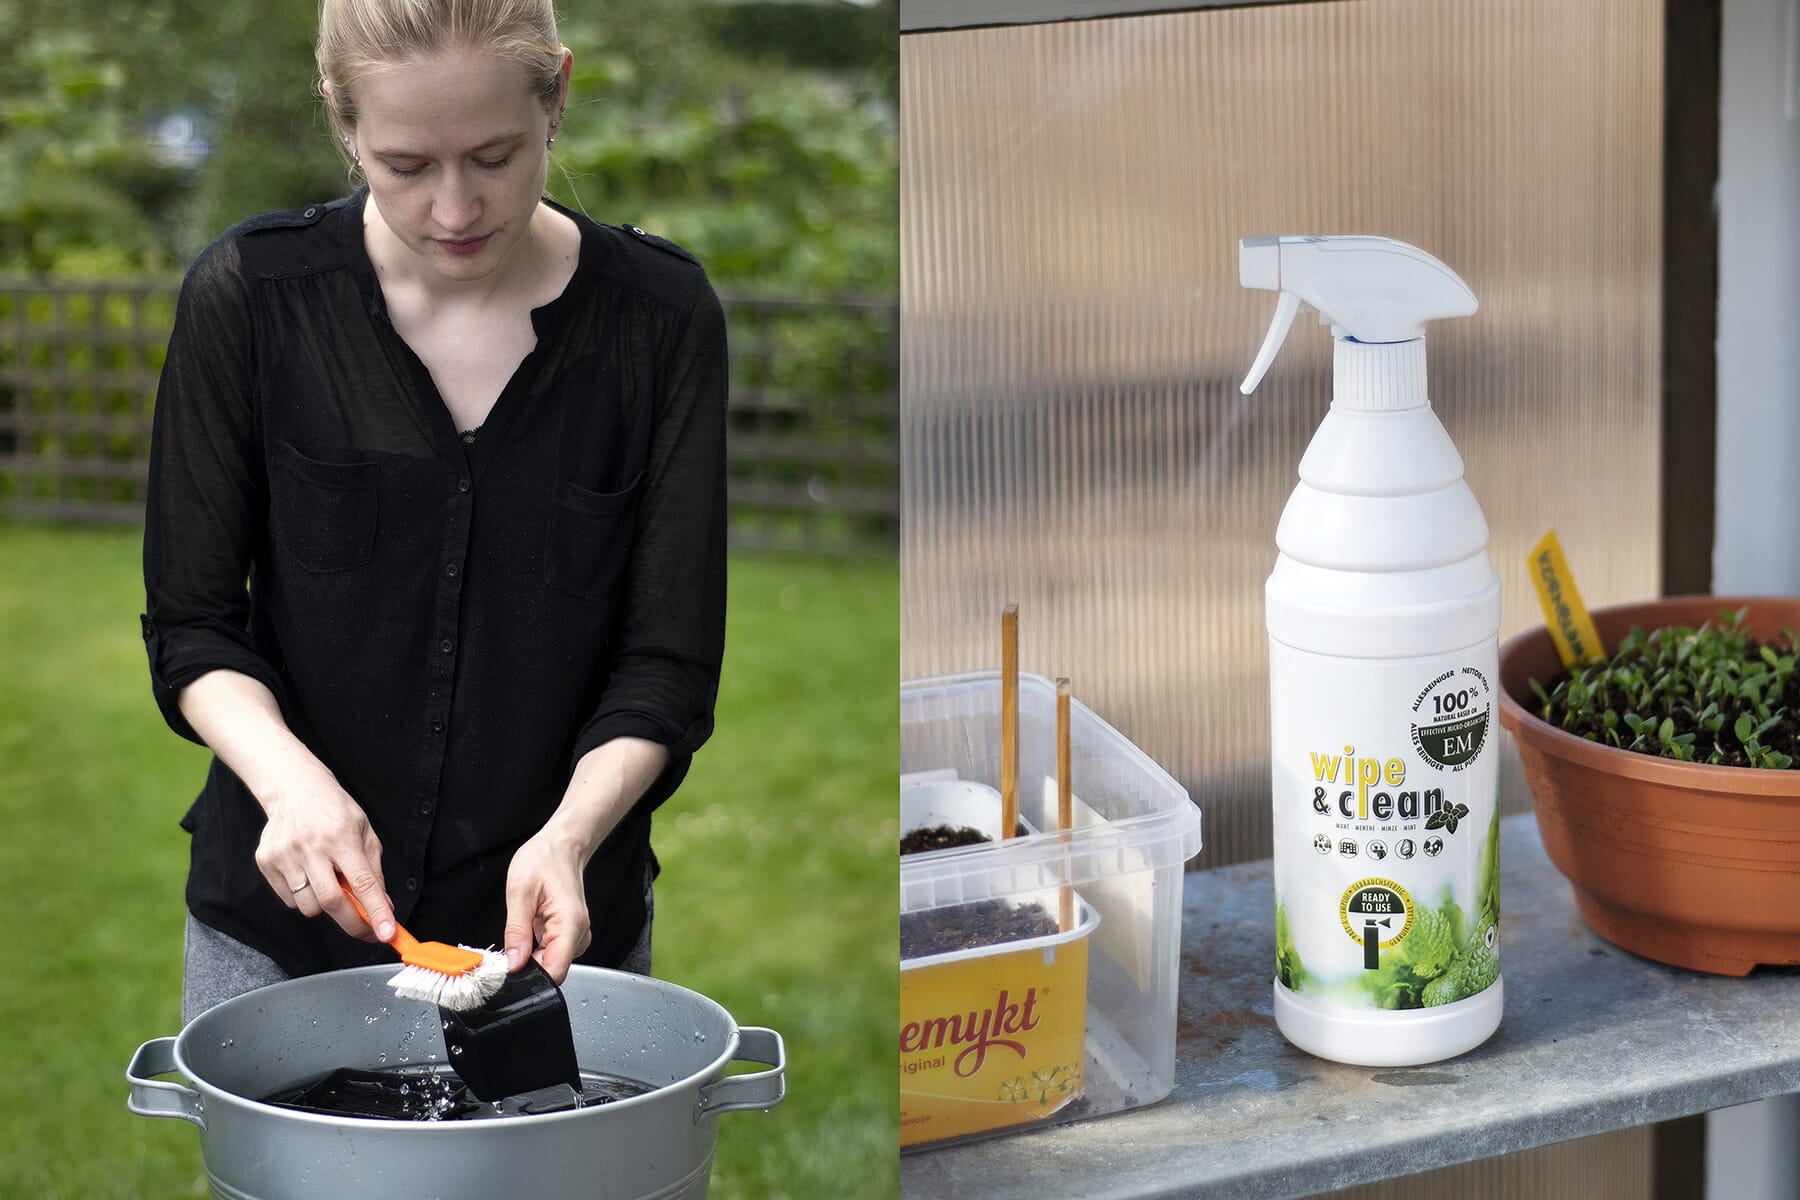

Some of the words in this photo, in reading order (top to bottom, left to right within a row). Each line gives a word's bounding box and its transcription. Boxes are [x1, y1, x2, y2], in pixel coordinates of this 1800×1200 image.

[1412, 670, 1455, 712] ALLESREINIGER
[1433, 686, 1479, 714] 100%
[1433, 713, 1456, 723] NATURAL
[1457, 709, 1470, 718] BASED
[1420, 726, 1446, 737] EFFECTIVE
[1411, 722, 1420, 746] ALLES
[1416, 745, 1445, 772] REINIGER
[1441, 731, 1473, 757] EM
[1452, 763, 1464, 773] ALL
[1310, 744, 1406, 818] wipe
[1312, 786, 1331, 815] &
[1338, 786, 1445, 820] clean
[1403, 823, 1417, 831] MINT
[1362, 892, 1390, 902] READY
[1361, 903, 1373, 912] TO
[1375, 903, 1392, 912] USE
